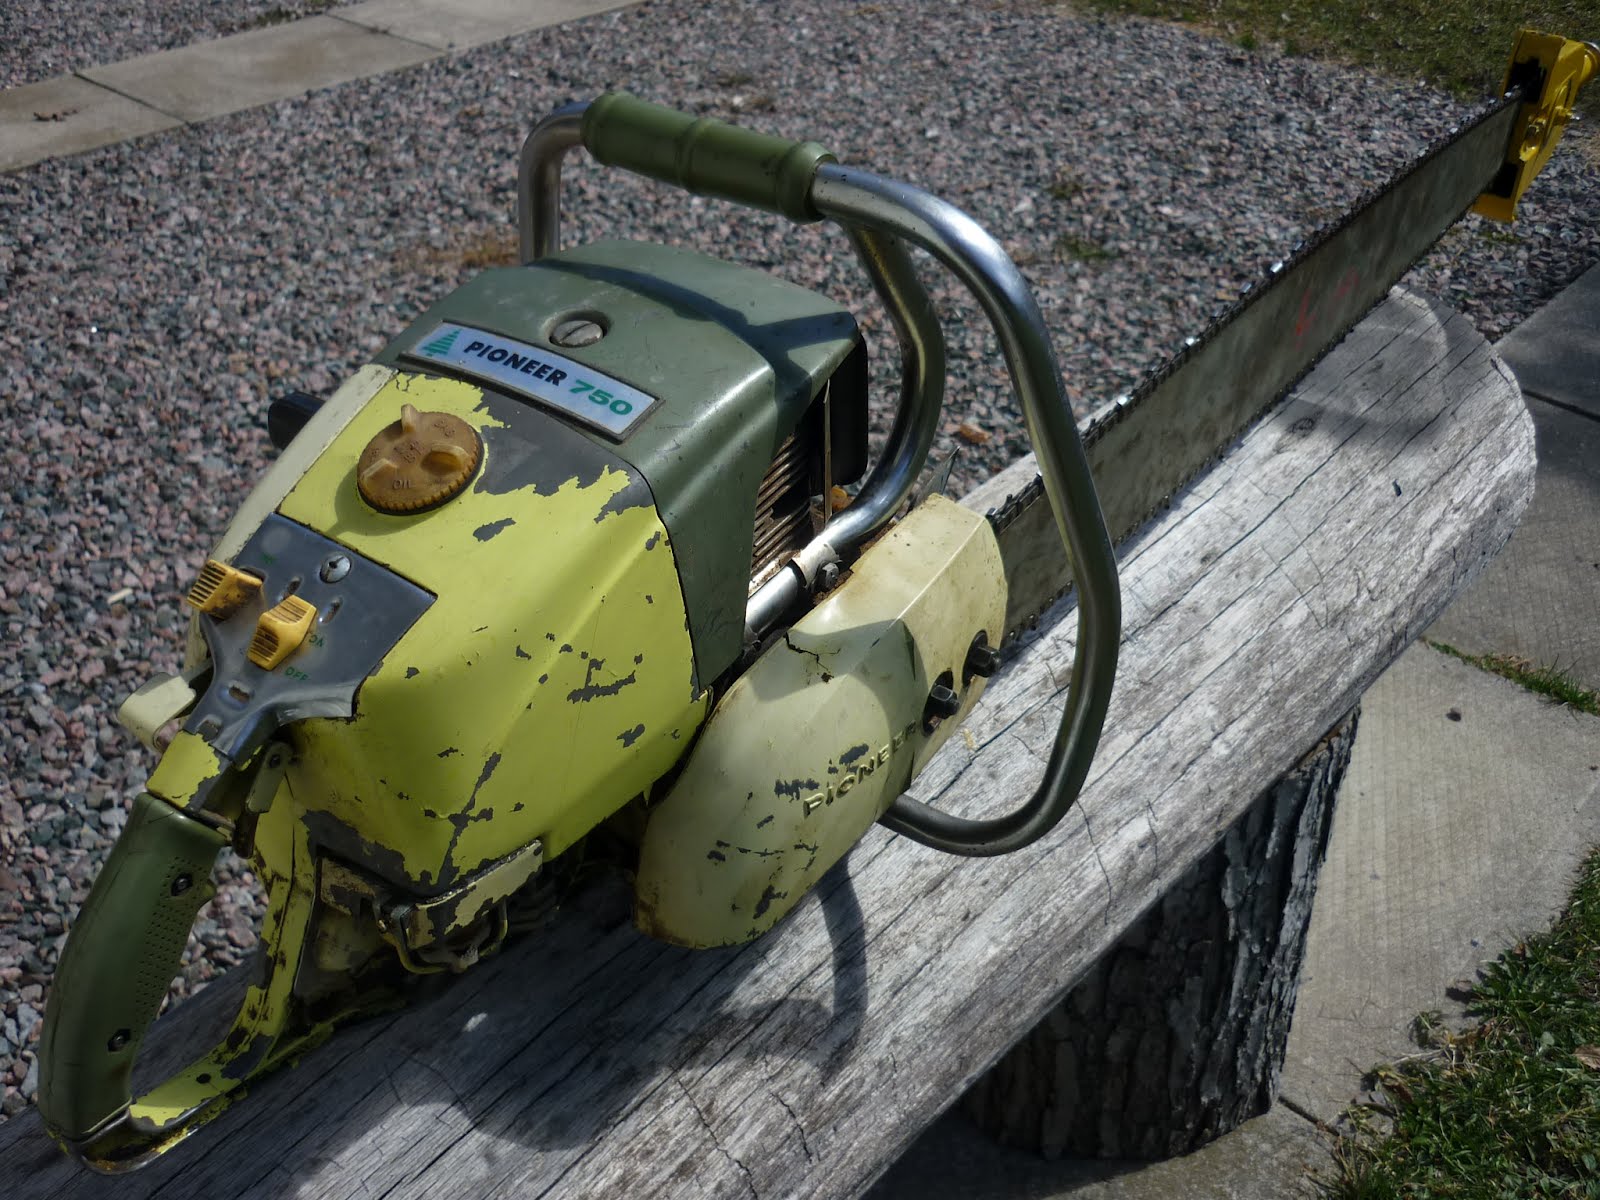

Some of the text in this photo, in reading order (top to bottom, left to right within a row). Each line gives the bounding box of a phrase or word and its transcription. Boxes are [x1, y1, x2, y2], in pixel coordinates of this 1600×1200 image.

[463, 341, 633, 416] PIONEER 750
[285, 665, 310, 681] OFF
[802, 720, 917, 820] PIONEER
